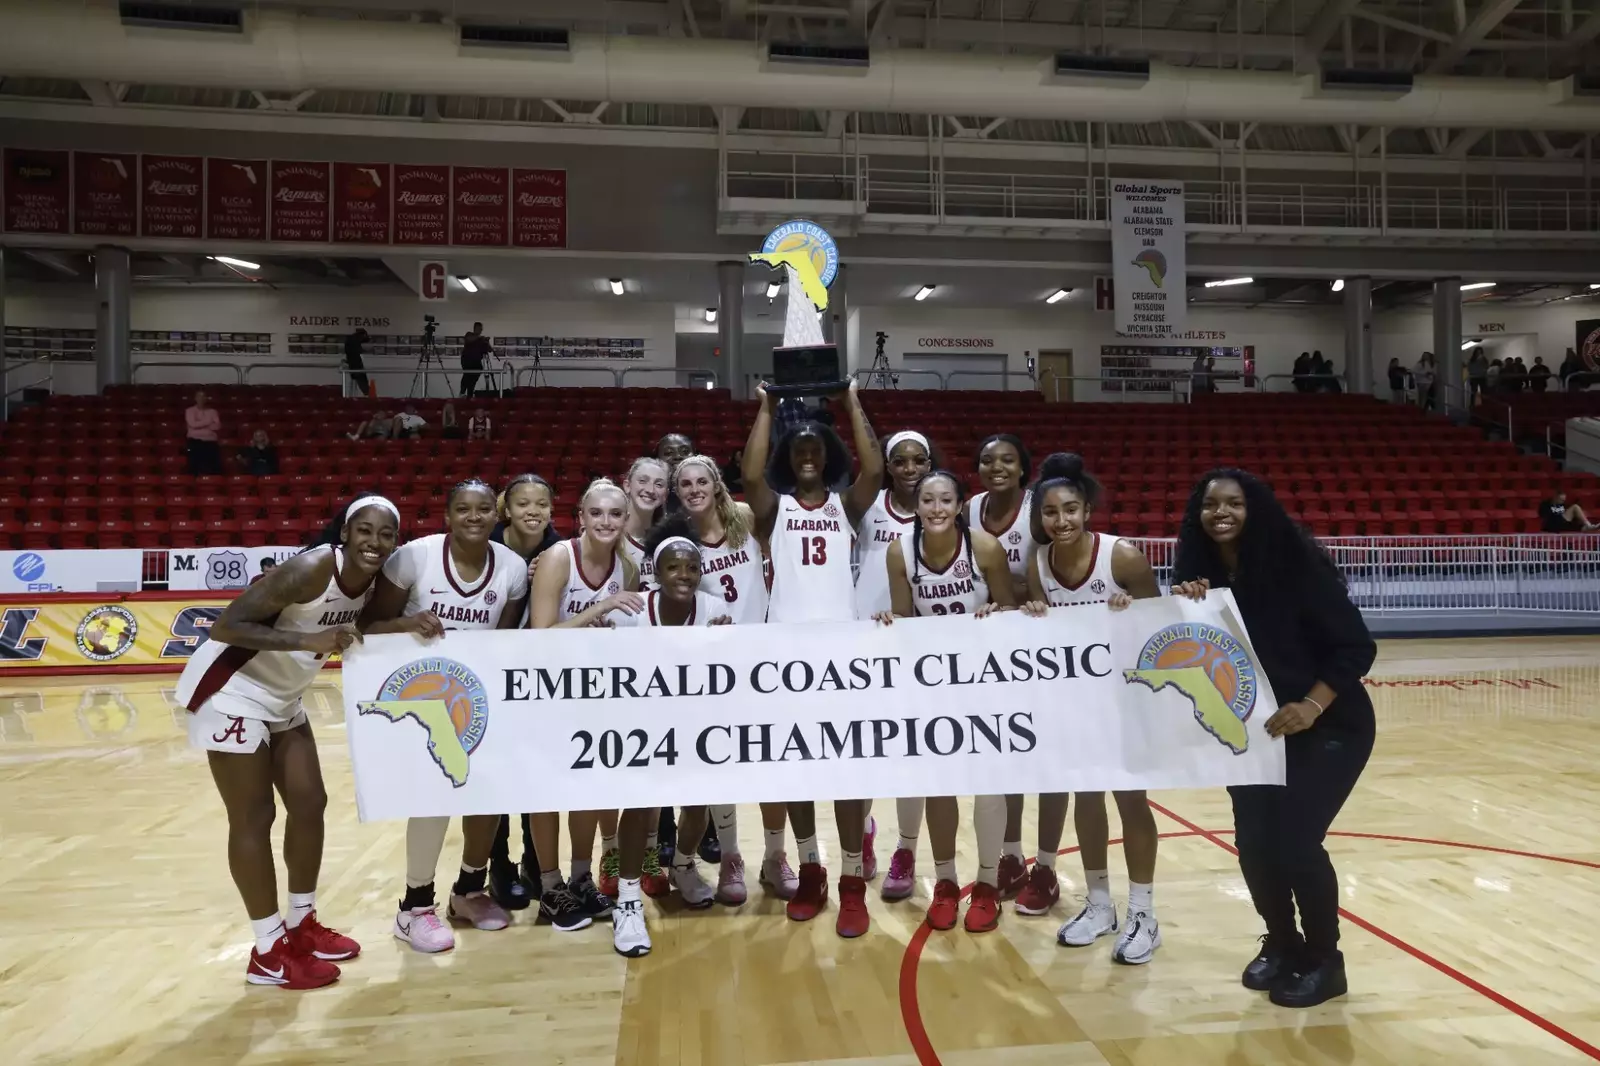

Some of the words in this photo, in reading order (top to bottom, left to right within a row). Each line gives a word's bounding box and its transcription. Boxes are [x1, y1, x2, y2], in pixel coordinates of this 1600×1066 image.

[147, 160, 196, 174] PANHANDLE
[275, 166, 325, 180] PANHANDLE
[398, 170, 445, 184] PANHANDLE
[457, 171, 502, 184] PANHANDLE
[516, 174, 563, 187] PANHANDLE
[1114, 184, 1147, 194] Global
[1149, 185, 1182, 196] Sports
[221, 196, 253, 205] NJCAA
[346, 201, 376, 210] NJCAA
[144, 206, 198, 214] CONFERENCE
[275, 209, 324, 218] CONFERENCE
[1133, 206, 1163, 214] ALABAMA
[277, 217, 325, 225] CHAMPIONS
[397, 212, 444, 221] CONFERENCE
[1123, 217, 1154, 225] ALABAMA
[1155, 217, 1173, 226] STATE
[149, 222, 174, 233] 1999
[182, 224, 196, 235] 00
[336, 220, 389, 229] CHAMPIONS
[398, 220, 442, 228] CHAMPIONS
[459, 222, 502, 230] CHAMPIONS
[518, 223, 559, 231] CHAMPIONS
[277, 228, 301, 238] 1998
[310, 228, 323, 238] 99
[338, 229, 362, 240] 1994
[371, 230, 385, 240] 95
[398, 230, 424, 240] 1994
[431, 231, 445, 240] 95
[1134, 228, 1163, 236] CLEMSON
[1142, 238, 1155, 247] UAB
[766, 223, 804, 251] EMERALD
[806, 224, 832, 247] COAST
[821, 246, 838, 283] CLASSIC
[422, 263, 445, 300] G
[1096, 278, 1114, 310] H
[1132, 292, 1167, 300] CREIGHTON
[1134, 303, 1165, 312] MISSOURI
[290, 316, 340, 326] RAIDER
[346, 316, 391, 327] TEAMS
[1133, 313, 1166, 322] SYRACUSE
[1127, 324, 1153, 333] WICHITA
[1155, 324, 1172, 333] STATE
[1478, 323, 1506, 333] MEN
[918, 337, 994, 348] CONCESSIONS
[786, 518, 840, 532] ALABAMA
[801, 536, 827, 566] 13
[700, 550, 750, 576] LABAMA
[213, 560, 241, 580] 98
[27, 583, 57, 592] FPL
[720, 574, 738, 603] 3
[918, 579, 975, 600] ALABAMA
[317, 608, 364, 626] ALABAM
[431, 601, 490, 624] ALABAMA
[77, 606, 111, 635] GLOBAL
[111, 606, 137, 633] SPORTS
[76, 634, 135, 661] MANAGEMENT
[501, 663, 736, 702] EMERALD
[749, 656, 901, 694] COAST
[913, 643, 1113, 688] CLASSIC
[1143, 625, 1192, 665] EMERALD
[1198, 626, 1240, 655] COAST
[1232, 657, 1253, 713] CLASSIC
[386, 659, 443, 696] EMERALD
[446, 662, 482, 692] COAST
[462, 695, 485, 746] CLASSIC
[212, 714, 247, 745] A
[570, 727, 679, 770] 2024
[696, 711, 1037, 765] CHAMPIONS
